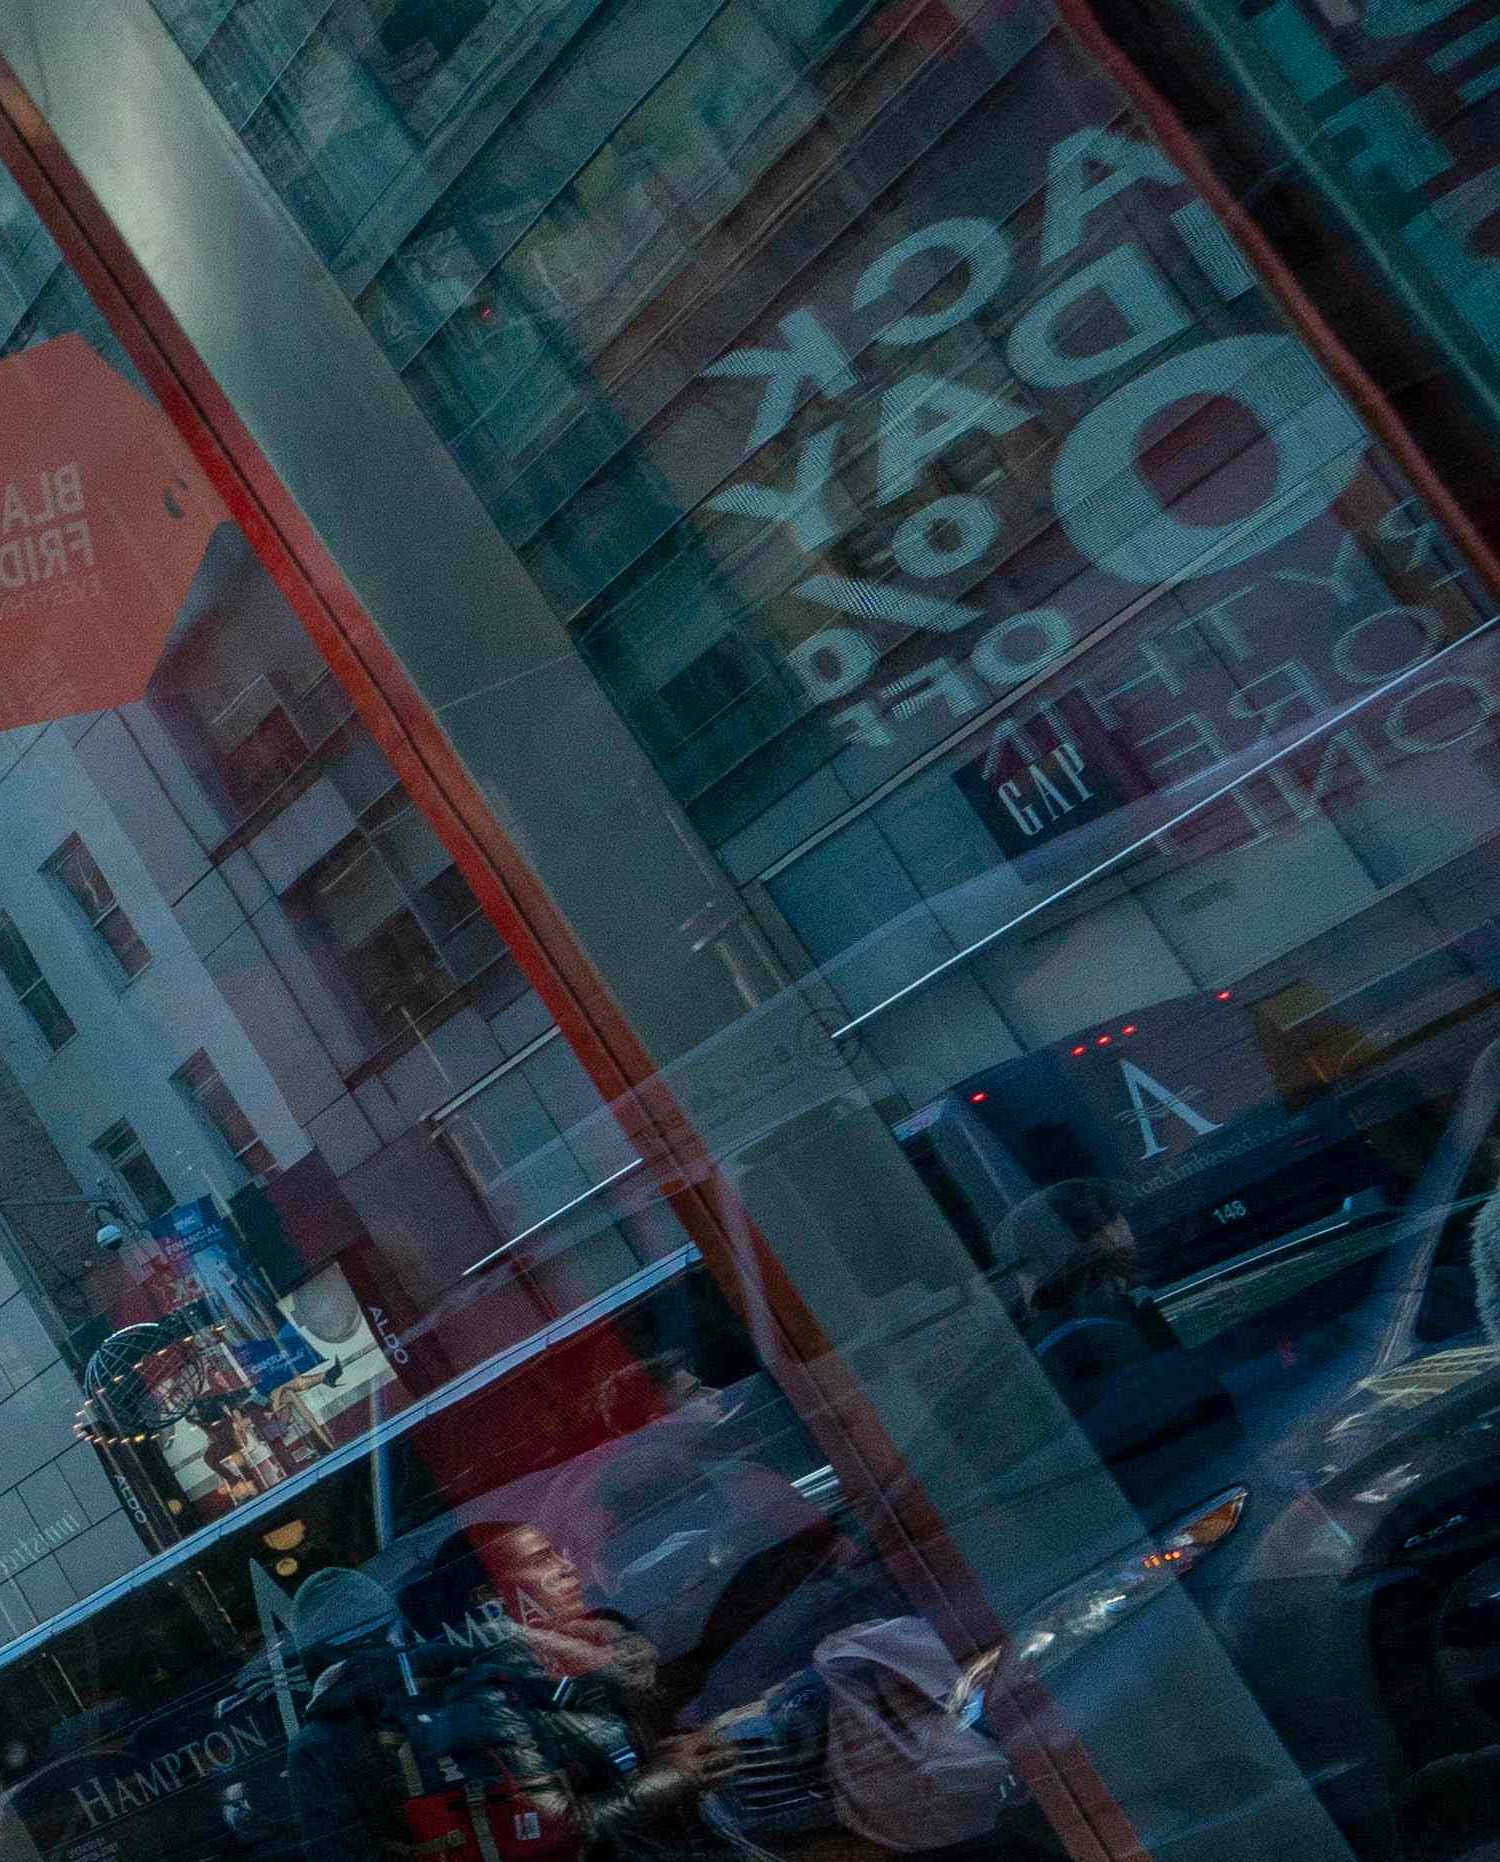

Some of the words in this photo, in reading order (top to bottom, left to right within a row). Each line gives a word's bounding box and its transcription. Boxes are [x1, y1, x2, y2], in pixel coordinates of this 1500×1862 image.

[994, 740, 1100, 840] GAP
[164, 1221, 223, 1256] FINANCIAL
[1211, 1198, 1248, 1227] 148
[366, 1302, 413, 1367] ALDO
[110, 1471, 150, 1527] ALDO
[67, 1713, 270, 1828] HAMPTON
